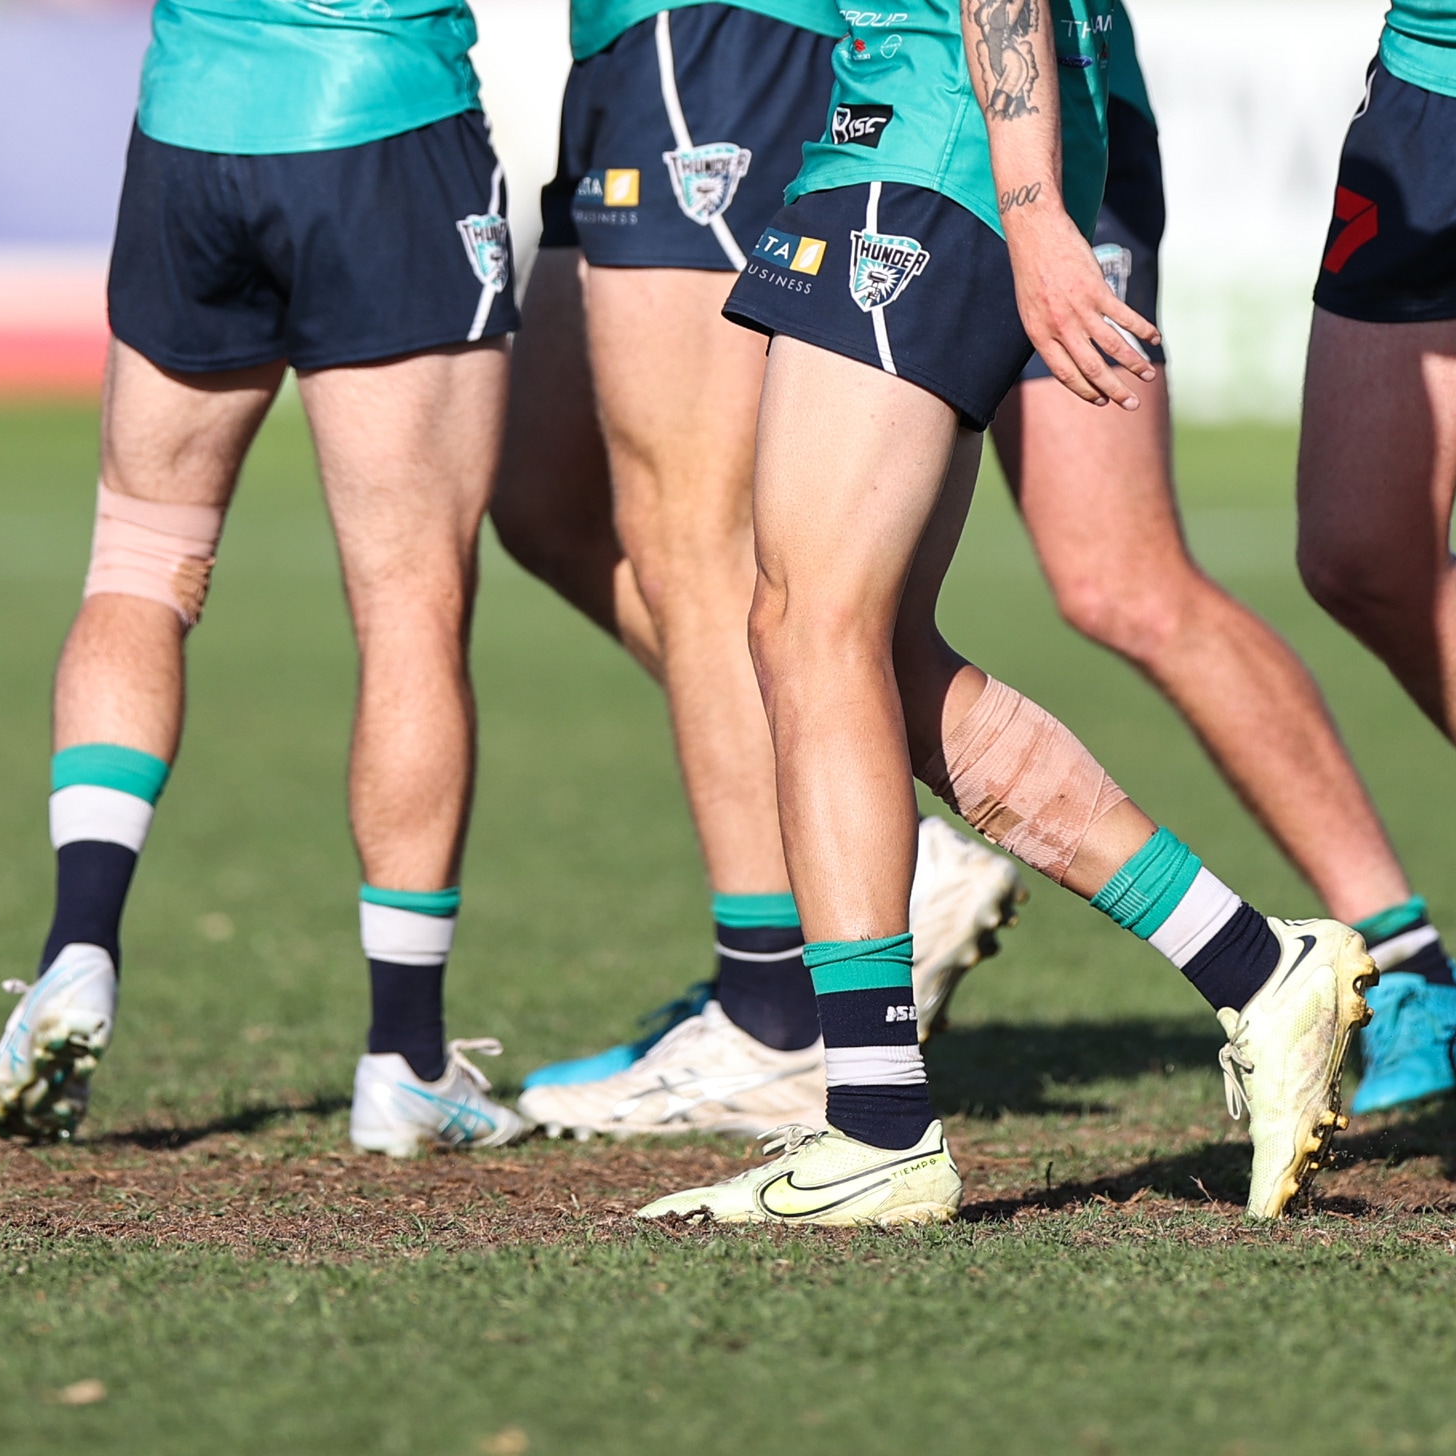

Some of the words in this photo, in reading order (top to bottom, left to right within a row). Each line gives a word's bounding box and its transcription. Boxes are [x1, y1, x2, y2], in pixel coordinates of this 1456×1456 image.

[849, 116, 887, 139] ISC
[755, 235, 790, 260] TA
[854, 233, 928, 280] THUNDER
[747, 262, 813, 295] USINESS
[891, 1158, 937, 1180] TIEMPO
